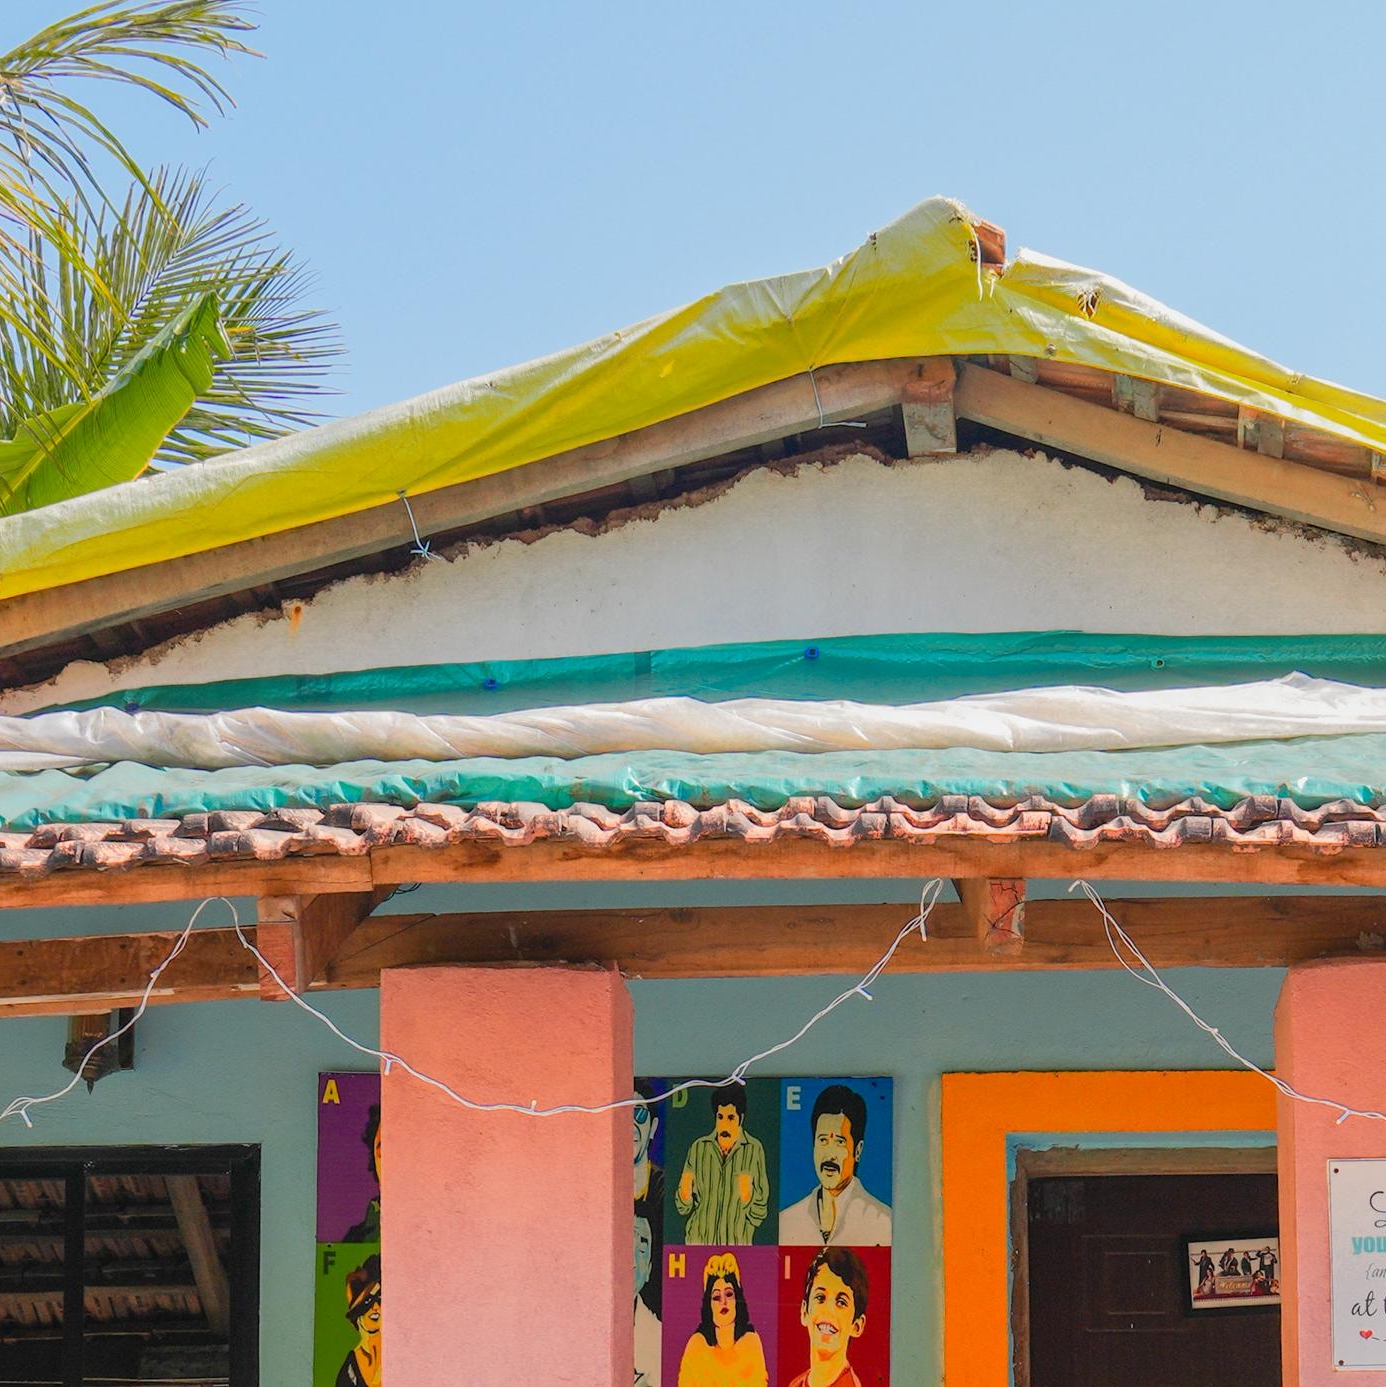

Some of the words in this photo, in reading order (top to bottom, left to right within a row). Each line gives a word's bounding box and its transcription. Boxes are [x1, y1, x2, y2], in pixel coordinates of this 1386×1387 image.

[322, 1079, 341, 1104] A
[672, 1083, 689, 1108] D
[786, 1086, 801, 1110] E
[323, 1251, 336, 1275] F
[668, 1253, 686, 1278] H
[784, 1255, 791, 1280] I
[1351, 1290, 1378, 1316] at
